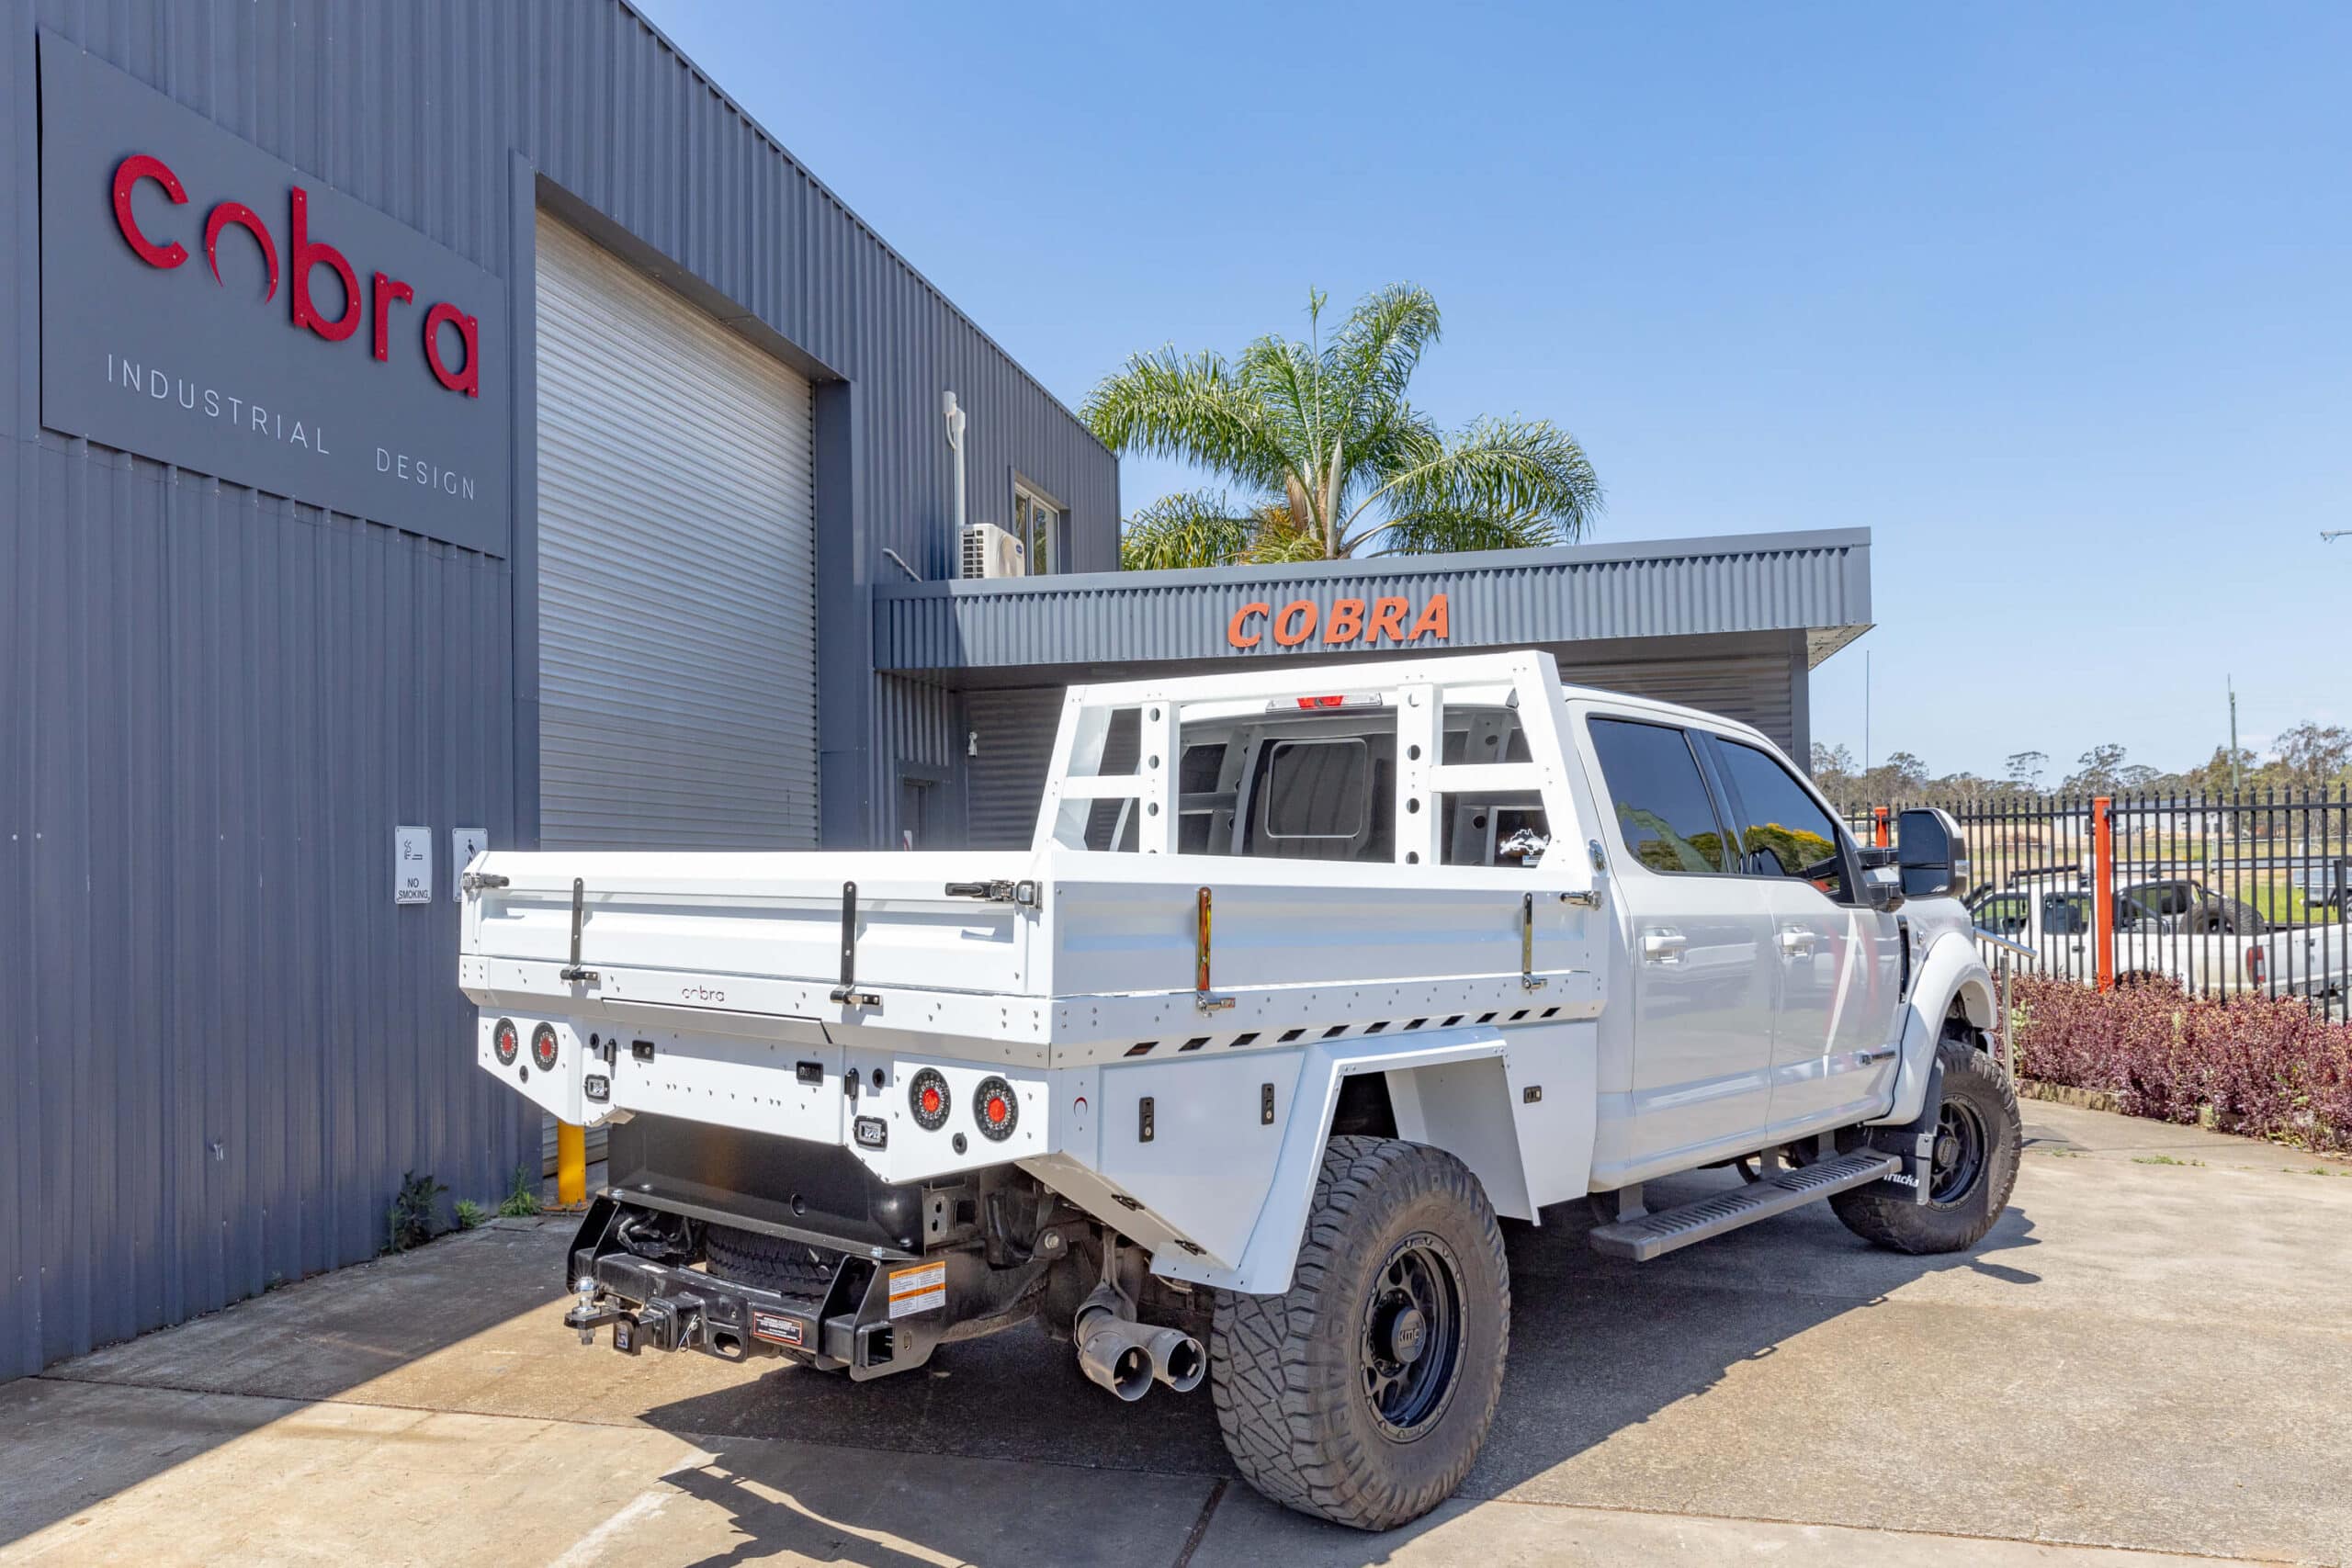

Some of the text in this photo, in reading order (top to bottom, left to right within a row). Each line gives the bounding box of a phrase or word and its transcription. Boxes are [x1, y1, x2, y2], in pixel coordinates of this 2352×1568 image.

[107, 353, 475, 502] INDUSTRIAL DESIGN
[1227, 593, 1449, 648] COBRA
[407, 877, 419, 888] NO
[398, 889, 428, 899] SMOKING
[682, 985, 725, 1002] cobra
